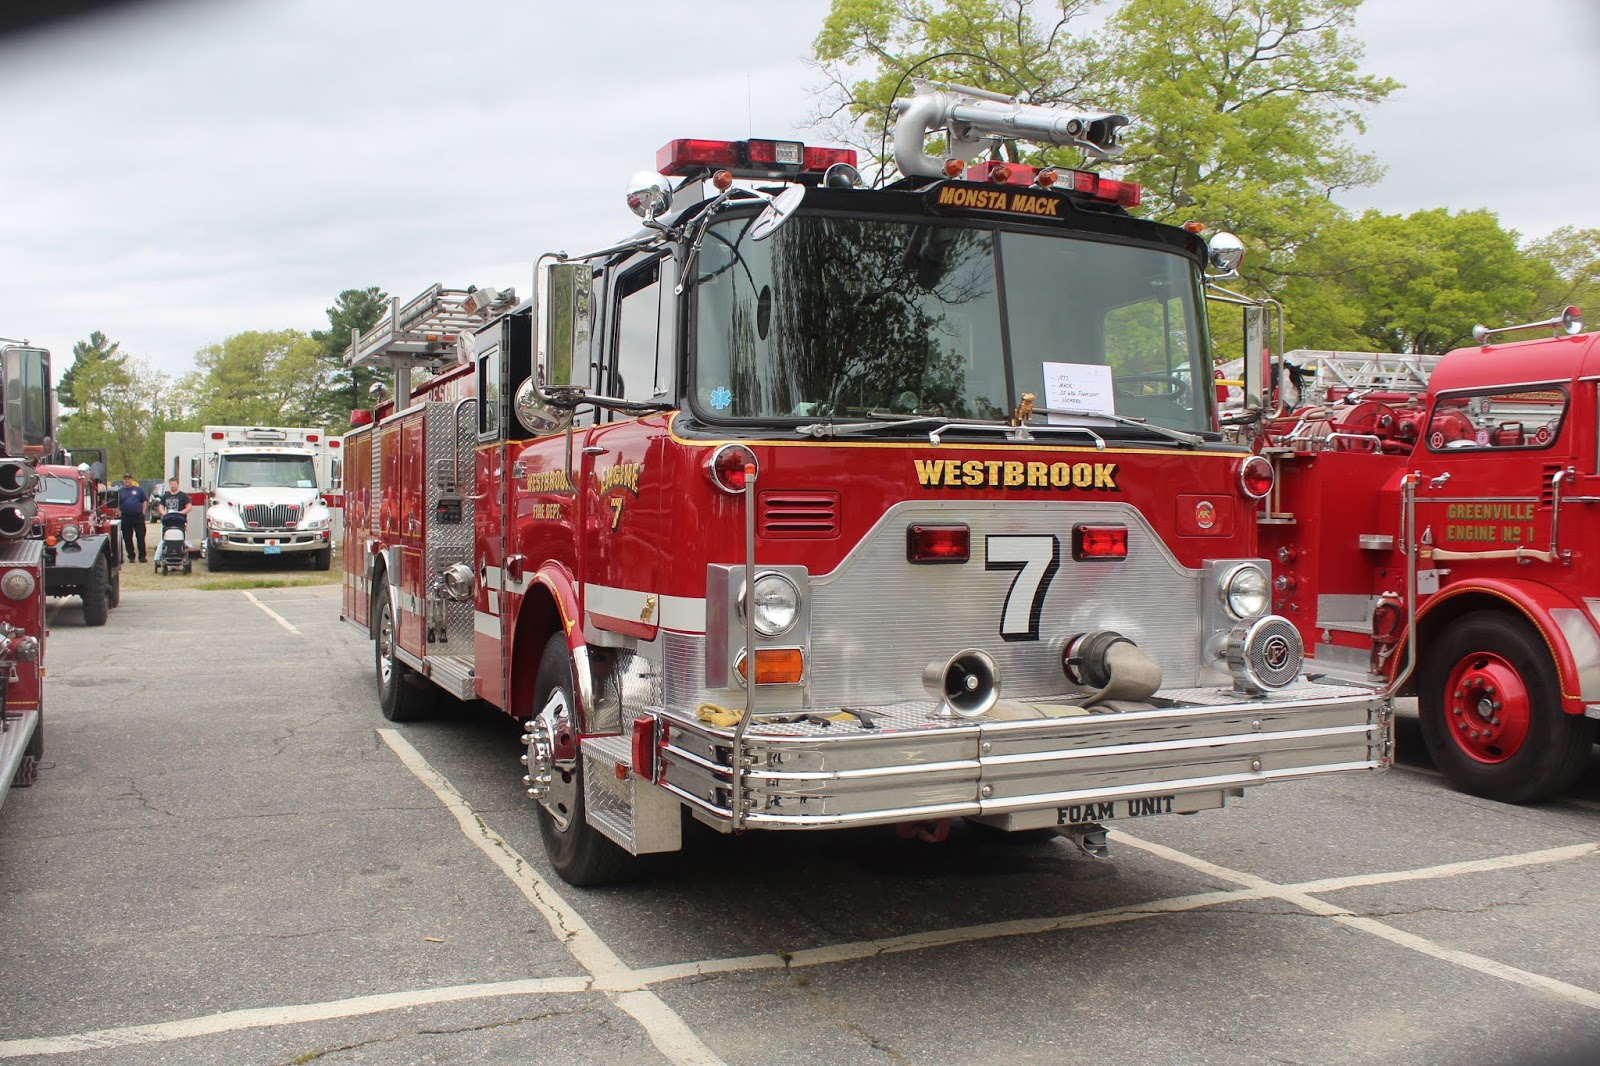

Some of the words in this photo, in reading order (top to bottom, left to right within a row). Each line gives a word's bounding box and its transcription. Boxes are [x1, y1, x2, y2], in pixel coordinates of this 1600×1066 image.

[939, 186, 1007, 210] MONSTA
[1011, 194, 1060, 216] MACK
[427, 378, 464, 402] RESCUE
[601, 463, 640, 496] ENGINE
[914, 459, 1119, 491] WESTBROOK
[533, 504, 545, 520] FIRE
[611, 498, 624, 531] 7
[1447, 504, 1535, 520] GREENVILLE
[1447, 525, 1497, 542] ENGINE
[985, 534, 1060, 642] 7
[1056, 802, 1115, 825] FOAM
[1128, 795, 1176, 817] UNIT
